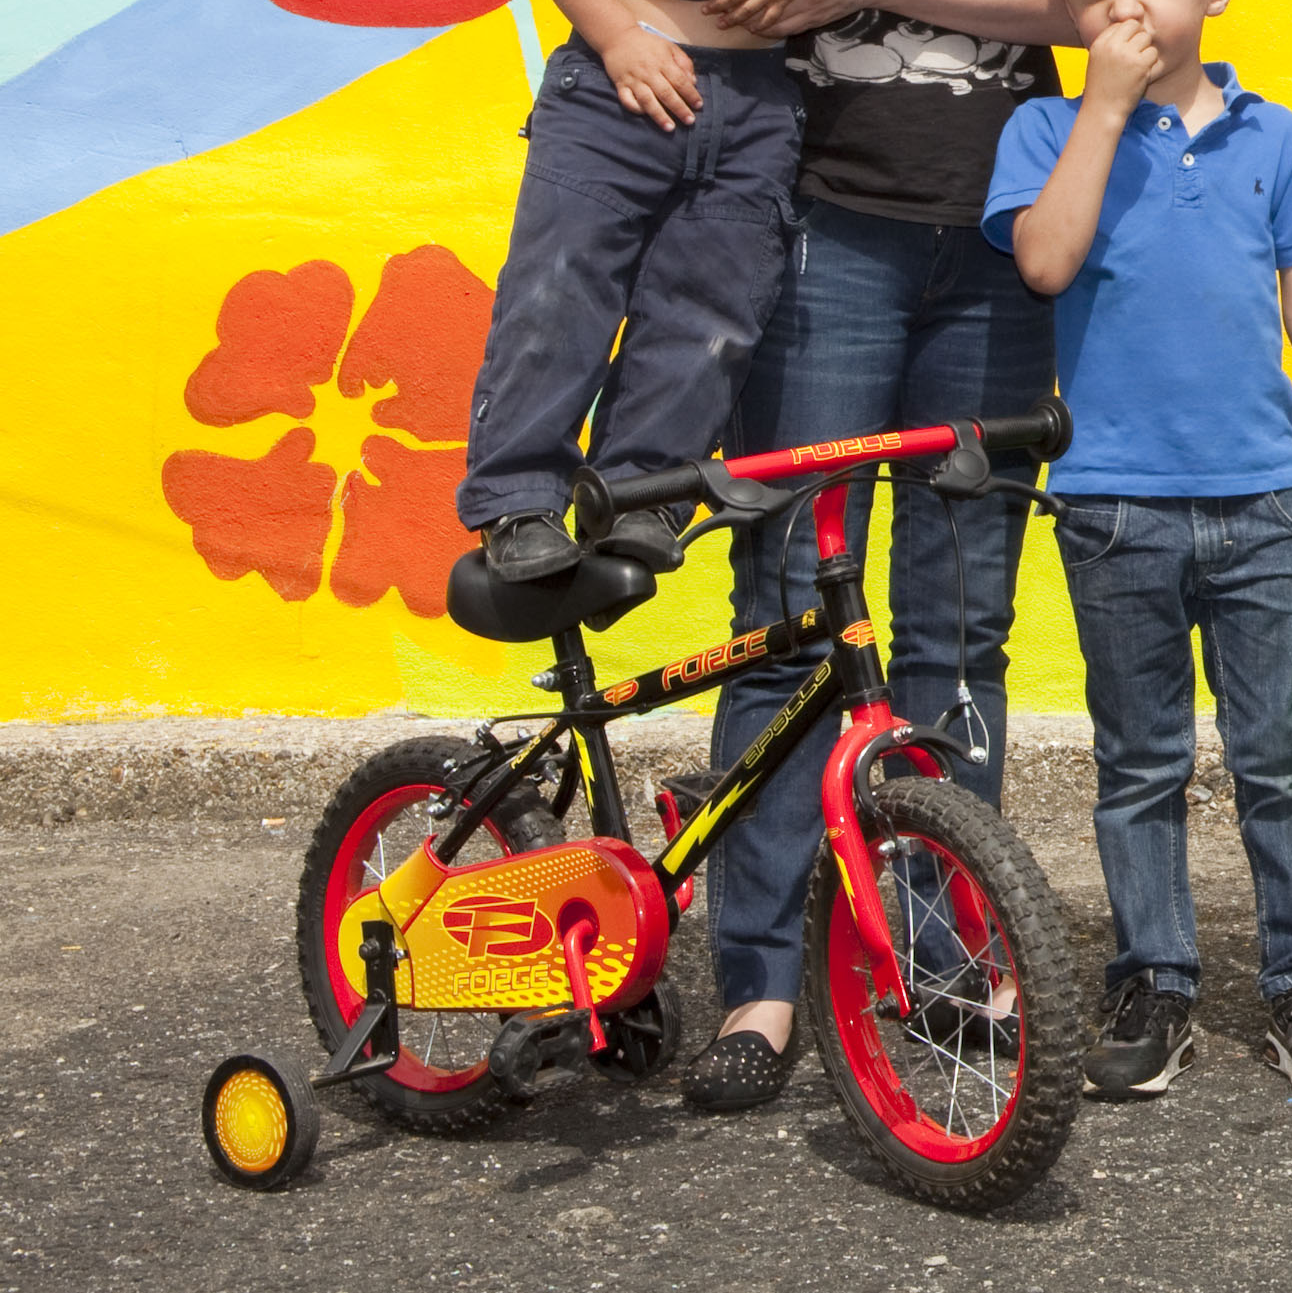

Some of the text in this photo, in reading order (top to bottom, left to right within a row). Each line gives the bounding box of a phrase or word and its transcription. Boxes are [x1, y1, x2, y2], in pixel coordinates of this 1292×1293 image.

[790, 432, 902, 465] FORCE
[661, 626, 770, 692] FORCE
[453, 963, 549, 996] FORCE
